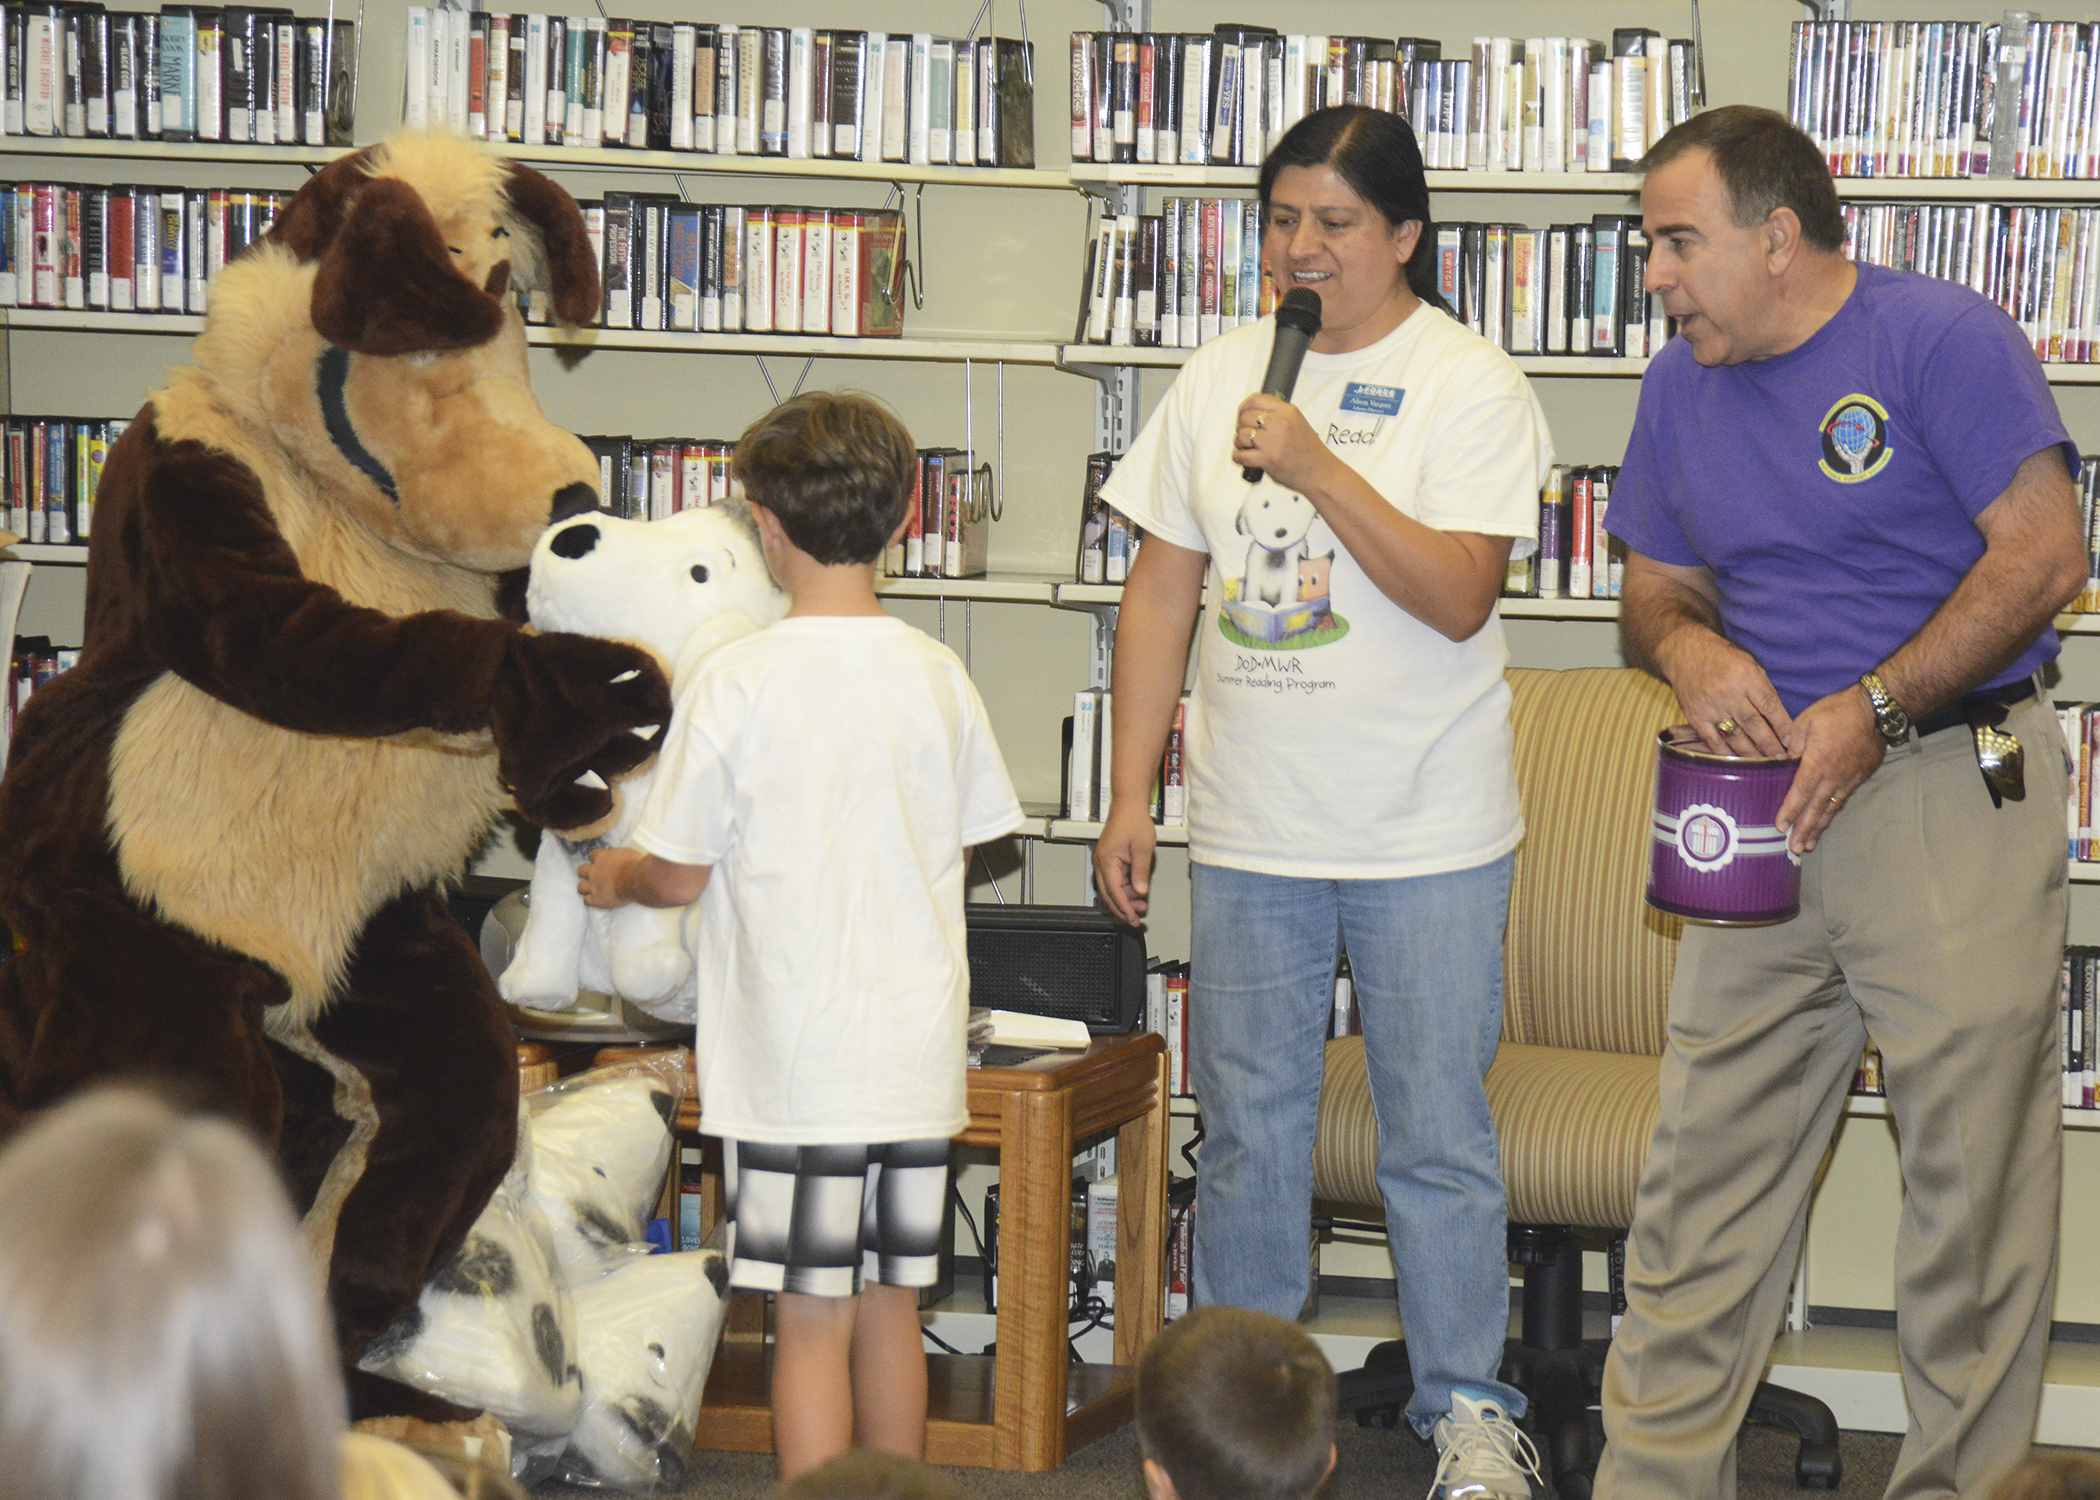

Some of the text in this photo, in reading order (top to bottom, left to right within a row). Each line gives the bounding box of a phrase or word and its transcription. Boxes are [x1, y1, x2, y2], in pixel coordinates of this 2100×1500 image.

[40, 37, 51, 100] MICHAEL CRICHTON
[121, 47, 131, 90] BLACK ECHO
[162, 55, 182, 97] MARKE
[279, 42, 291, 106] MICHAEL CRICHTON
[432, 38, 440, 87] ARMAGEDDON
[680, 61, 688, 101] MURDER
[1072, 50, 1085, 115] mysteries
[1143, 71, 1153, 103] crucial
[1268, 64, 1281, 103] blink
[743, 83, 751, 119] djibou
[1221, 89, 1232, 110] YES
[1207, 215, 1215, 228] RON
[1245, 216, 1255, 229] RON
[608, 223, 618, 265] PROFESSION
[618, 226, 628, 262] THE FIFTH
[647, 207, 655, 296] MAN IN MY BASEMENT
[672, 221, 684, 279] MELTZER
[686, 232, 697, 270] BRAD
[1165, 228, 1174, 257] HUBBARD
[1206, 228, 1215, 258] HUBBARD
[1245, 229, 1255, 259] HUBBARD
[1515, 241, 1524, 279] DEMOCRACY
[88, 252, 102, 274] ROO
[1445, 251, 1453, 287] SWITCH
[1205, 279, 1214, 307] ORIGINAL
[1245, 276, 1255, 317] SCIENTOLO
[601, 459, 610, 506] POST CAPTAIN
[1093, 468, 1101, 485] SEAL
[1596, 503, 1605, 519] START
[1541, 526, 1550, 560] LANGUAGE
[1216, 672, 1336, 695] Summer Reading Program
[2084, 964, 2095, 1035] CONSTANTINE
[1179, 1221, 1188, 1253] Pinheads
[1179, 1253, 1187, 1267] and
